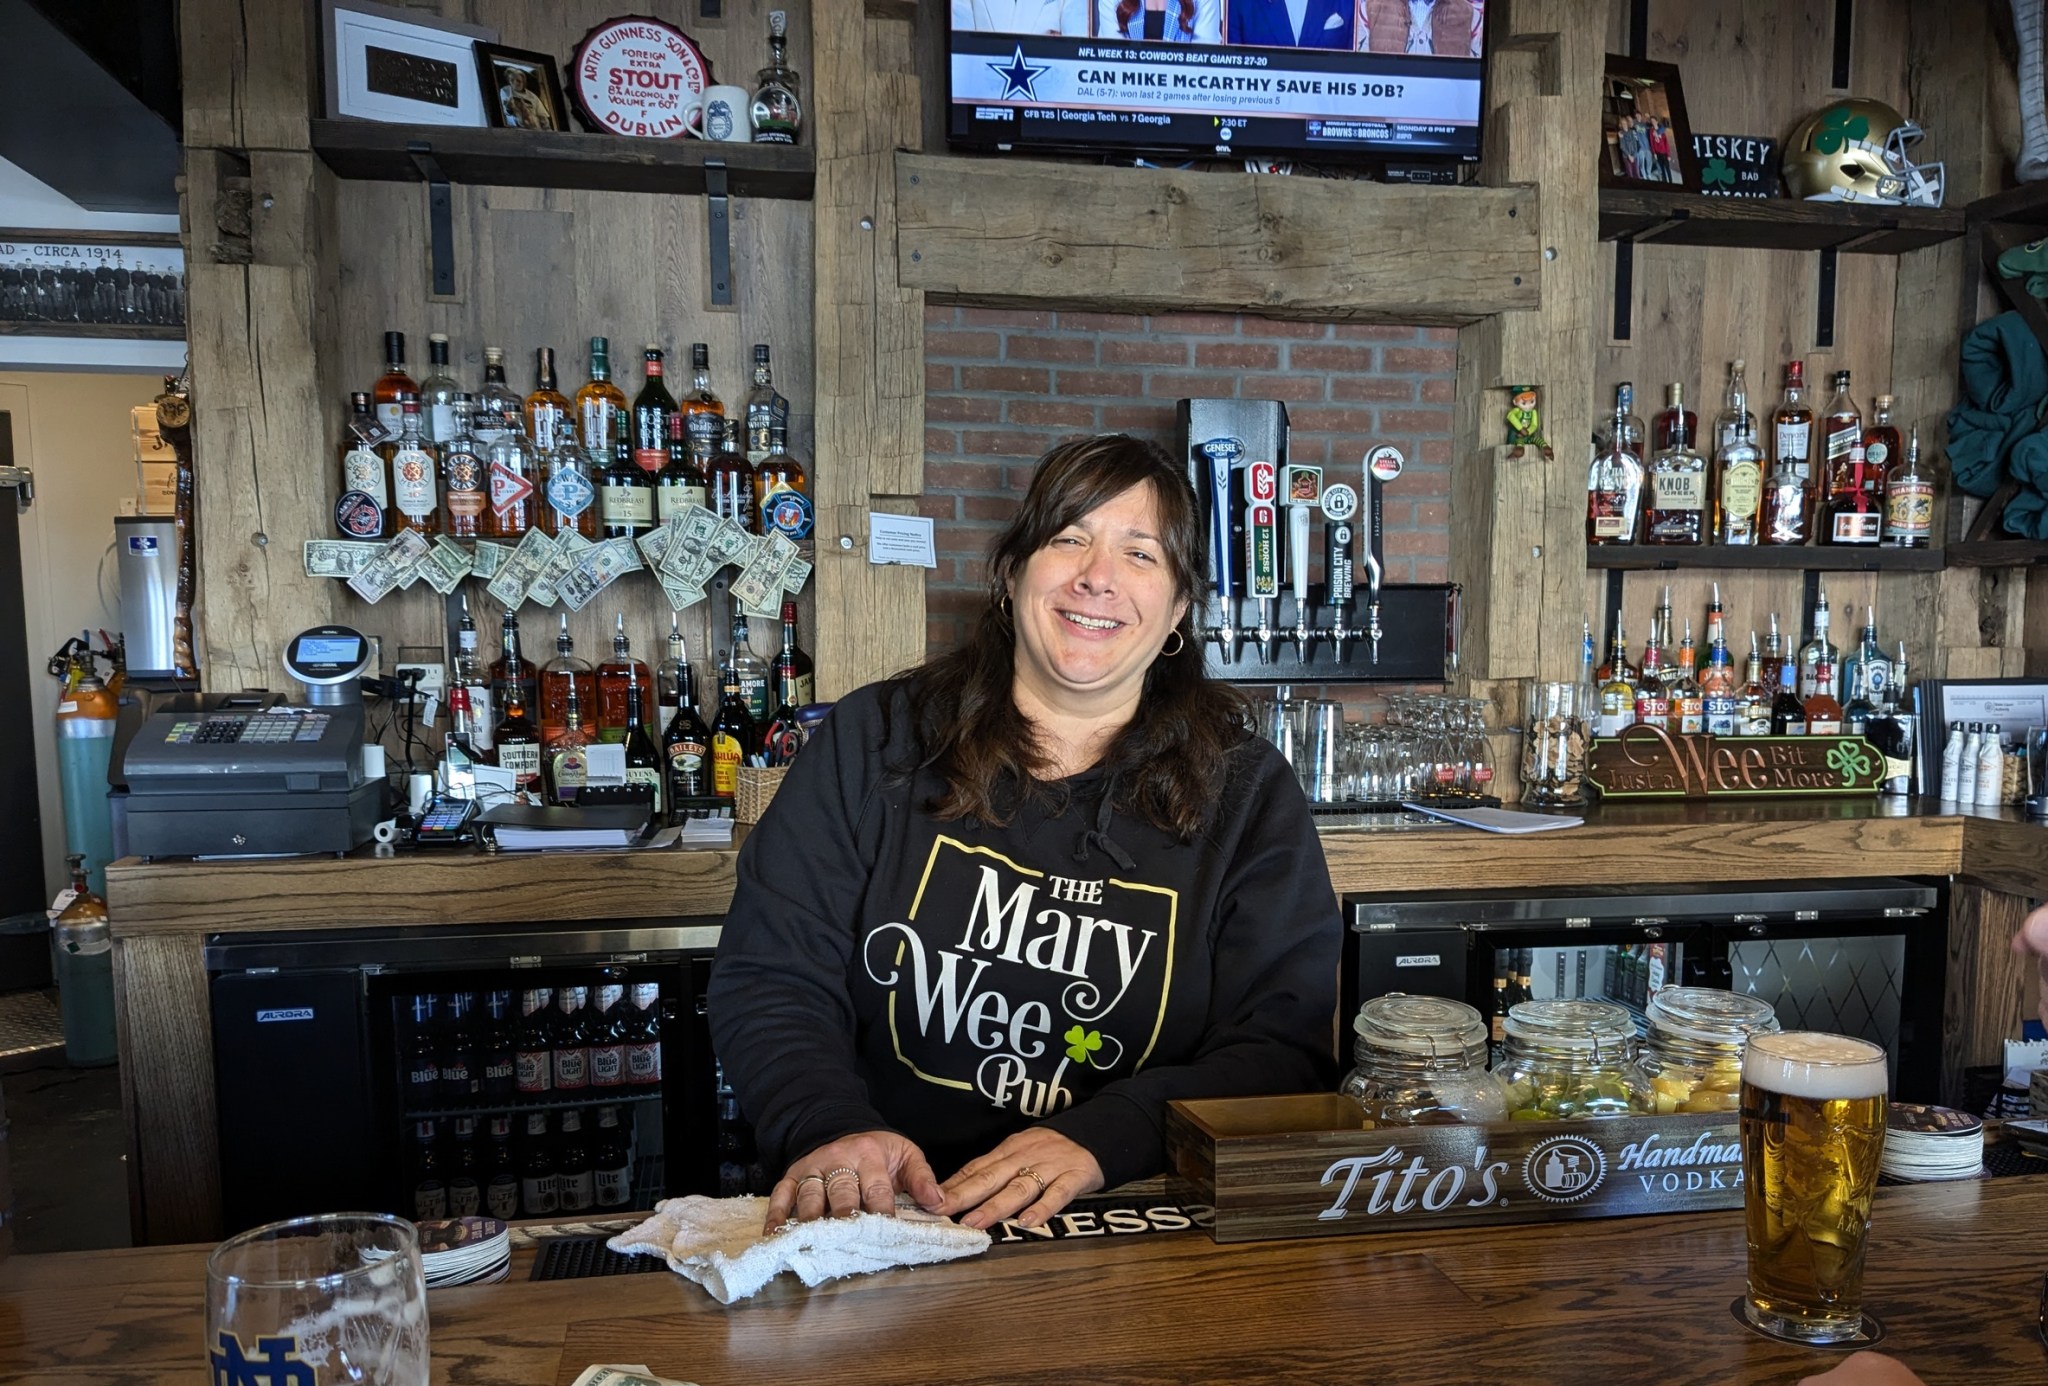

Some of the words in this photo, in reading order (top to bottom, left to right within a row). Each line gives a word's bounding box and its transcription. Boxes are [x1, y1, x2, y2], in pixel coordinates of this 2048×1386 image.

[600, 26, 662, 49] GUINNESS
[665, 37, 688, 60] SON
[622, 49, 665, 61] FOREIGN
[1078, 47, 1096, 58] NFL
[1098, 48, 1123, 59] WEEK
[1125, 50, 1137, 60] 13:
[1139, 51, 1184, 62] COWBOYS
[1186, 52, 1209, 63] BEAT
[1210, 54, 1243, 65] GIANTS
[1244, 55, 1268, 66] 27-20
[630, 59, 661, 69] EXTRA
[609, 68, 682, 90] STOUT
[1078, 69, 1119, 84] CAN
[1122, 71, 1168, 87] MIKE
[1173, 73, 1271, 92] McCARTHY
[1276, 79, 1322, 94] SAVE
[1327, 82, 1357, 96] HIS
[1362, 83, 1404, 98] JOB?
[608, 95, 645, 107] VOLUME
[624, 88, 666, 100] ALCOHOL
[668, 93, 680, 101] BY
[1078, 87, 1095, 97] DAL
[1120, 90, 1137, 98] won
[1139, 89, 1155, 99] last
[1156, 90, 1162, 99] 2
[1163, 92, 1191, 102] games
[1192, 91, 1210, 101] after
[1212, 93, 1238, 105] losing
[1239, 95, 1273, 106] previous
[1275, 96, 1281, 105] 5
[976, 107, 1014, 120] ESPN
[1024, 110, 1039, 119] CFB
[1041, 110, 1055, 119] T25
[1061, 110, 1095, 122] Georgia
[1097, 111, 1117, 122] Tech
[1119, 114, 1129, 122] vs
[1131, 113, 1137, 123] 7
[1138, 113, 1171, 125] Georgia
[1238, 118, 1248, 127] ET
[605, 110, 682, 137] DUBLIN
[1322, 126, 1353, 137] BROWNS
[1358, 128, 1389, 139] BRONCOS
[1693, 136, 1770, 165] HISKEY
[1741, 171, 1759, 181] BAD
[33, 245, 81, 257] CIRCA
[86, 247, 122, 259] 1914
[748, 421, 771, 430] WHIST
[1205, 444, 1236, 453] GENESEE
[350, 479, 378, 489] HEART
[450, 479, 478, 489] HEART
[1659, 477, 1690, 491] KNOB
[562, 484, 578, 501] P
[623, 510, 632, 518] 15
[1262, 528, 1269, 538] 12
[1262, 540, 1270, 573] HORSE
[1333, 547, 1343, 567] CITY
[1333, 570, 1343, 598] PRISON
[1344, 559, 1352, 598] BREWING
[740, 679, 765, 688] AMORE
[470, 695, 484, 708] EAM
[502, 750, 539, 760] SOUTHERN
[669, 742, 704, 754] BAILEYS
[712, 749, 740, 762] AHLÚA
[1622, 722, 1768, 796] Wee
[1769, 745, 1807, 766] Bit
[505, 760, 537, 769] COMFORT
[1609, 769, 1656, 790] Just
[1664, 774, 1676, 789] a
[1772, 768, 1836, 788] More
[1049, 875, 1104, 905] THE
[955, 865, 1158, 1022] Mary
[1398, 957, 1439, 965] AURORA
[864, 922, 1051, 1058] Wee
[259, 1010, 310, 1021] AURORA
[561, 1058, 582, 1070] Blue
[597, 1056, 617, 1068] Blue
[631, 1053, 651, 1064] Blue
[486, 1065, 514, 1078] Blue
[561, 1066, 582, 1076] LIGHT
[597, 1064, 617, 1074] LIGHT
[631, 1061, 651, 1071] LIGHT
[411, 1068, 439, 1083] Blue
[442, 1067, 469, 1081] Blue
[976, 1053, 1073, 1118] Pub
[1617, 1131, 1742, 1171] Handma
[598, 1172, 619, 1187] Lite
[1318, 1145, 1509, 1220] Tito's
[1639, 1171, 1745, 1193] VODKA
[1003, 1207, 1194, 1241] NESS
